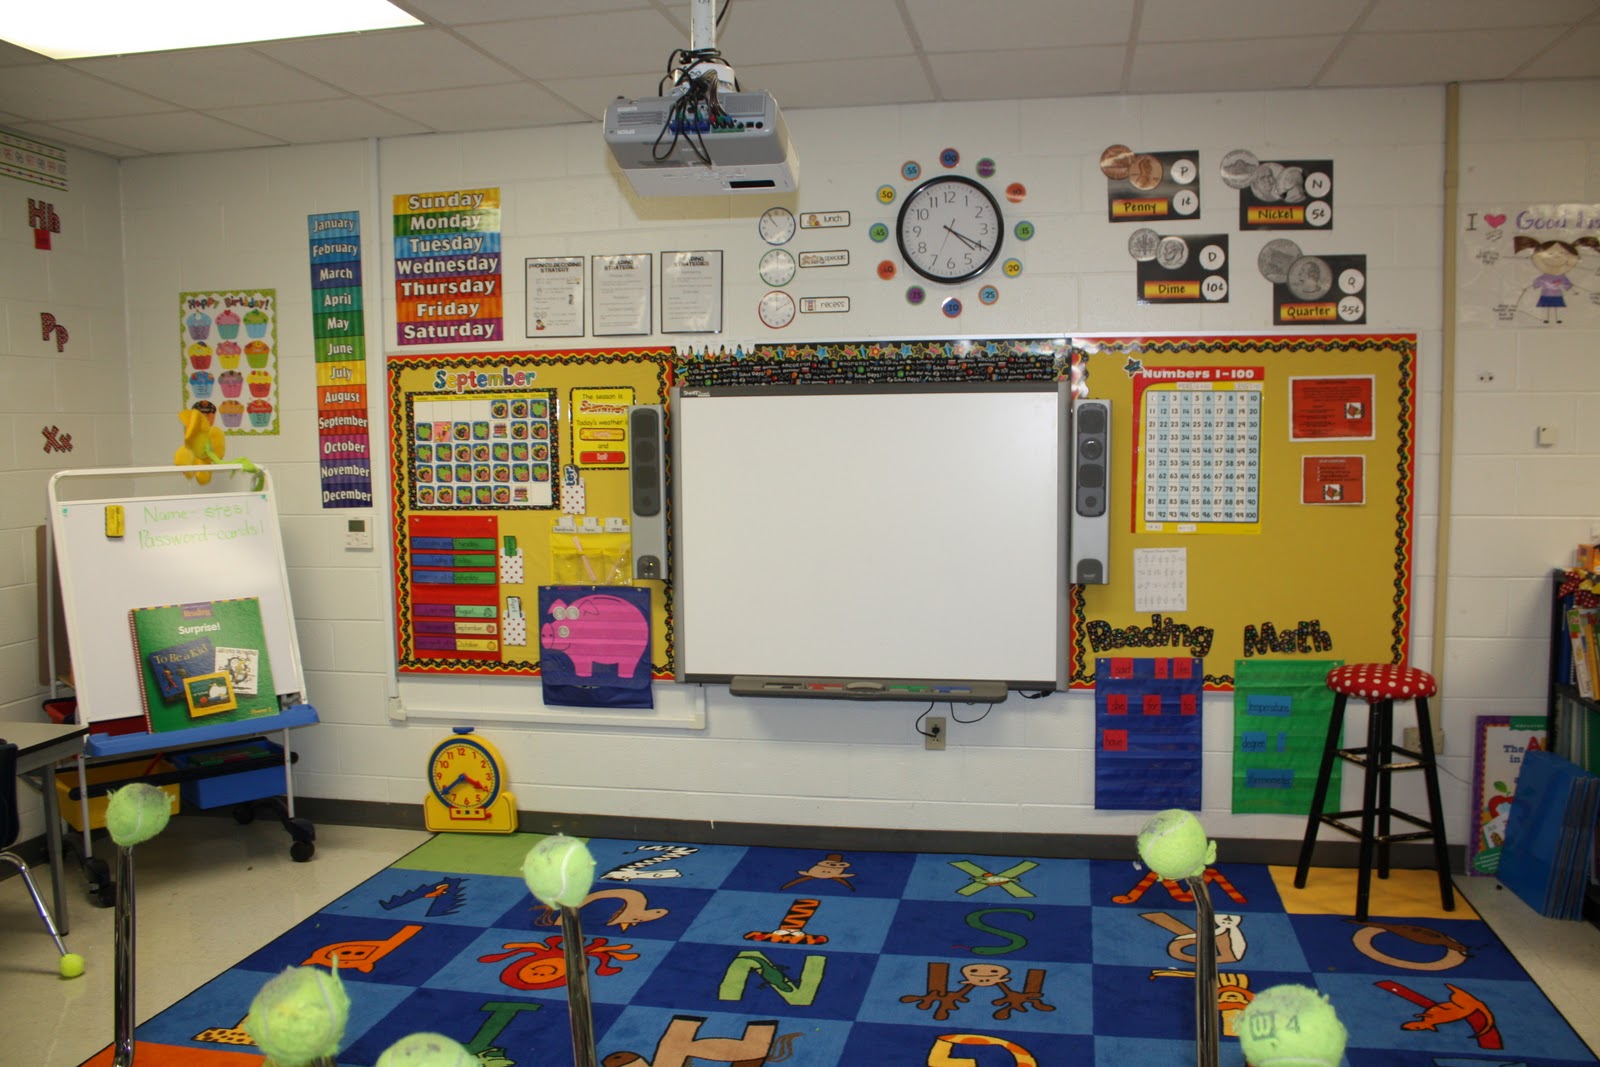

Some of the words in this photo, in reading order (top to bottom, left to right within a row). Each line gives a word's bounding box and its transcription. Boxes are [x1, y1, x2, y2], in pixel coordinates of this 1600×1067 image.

[1181, 167, 1188, 176] P
[1312, 180, 1322, 189] N
[408, 192, 484, 210] Sunday
[929, 197, 938, 208] 11
[944, 191, 956, 203] 12
[965, 195, 968, 206] 1
[916, 208, 929, 220] 10
[975, 206, 983, 218] 2
[1124, 202, 1156, 214] Penny
[1258, 208, 1294, 219] Nickel
[313, 219, 354, 232] January
[410, 212, 482, 231] Monday
[1466, 213, 1478, 231] I
[1516, 210, 1567, 230] Good
[913, 226, 921, 237] 9
[980, 224, 988, 235] 3
[313, 244, 358, 257] February
[410, 235, 483, 254] Tuesday
[918, 242, 926, 253] 8
[931, 255, 938, 266] 7
[965, 253, 972, 265] 5
[1209, 252, 1216, 261] D
[397, 256, 498, 275] Wednesday
[946, 257, 956, 269] 6
[320, 268, 353, 281] March
[401, 279, 495, 297] Thursday
[1348, 277, 1356, 287] Q
[1158, 285, 1185, 293] Dime
[324, 294, 351, 306] April
[416, 301, 479, 318] Friday
[1288, 306, 1330, 318] Quarter
[327, 317, 349, 330] May
[404, 322, 495, 340] Saturday
[328, 343, 353, 355] June
[330, 366, 352, 380] July
[1143, 370, 1210, 378] Numbers
[434, 368, 535, 393] September
[325, 392, 360, 403] August
[580, 401, 629, 414] Summer
[319, 416, 368, 429] September
[324, 442, 366, 454] October
[321, 465, 370, 478] November
[323, 490, 371, 503] December
[178, 622, 221, 635] Surprise!
[1086, 614, 1214, 658] Reading
[1244, 620, 1332, 658] Math
[154, 655, 168, 664] To
[169, 653, 182, 662] Be
[190, 644, 209, 656] Kid
[457, 748, 466, 756] 12
[1503, 745, 1524, 753] The
[464, 797, 470, 805] 6
